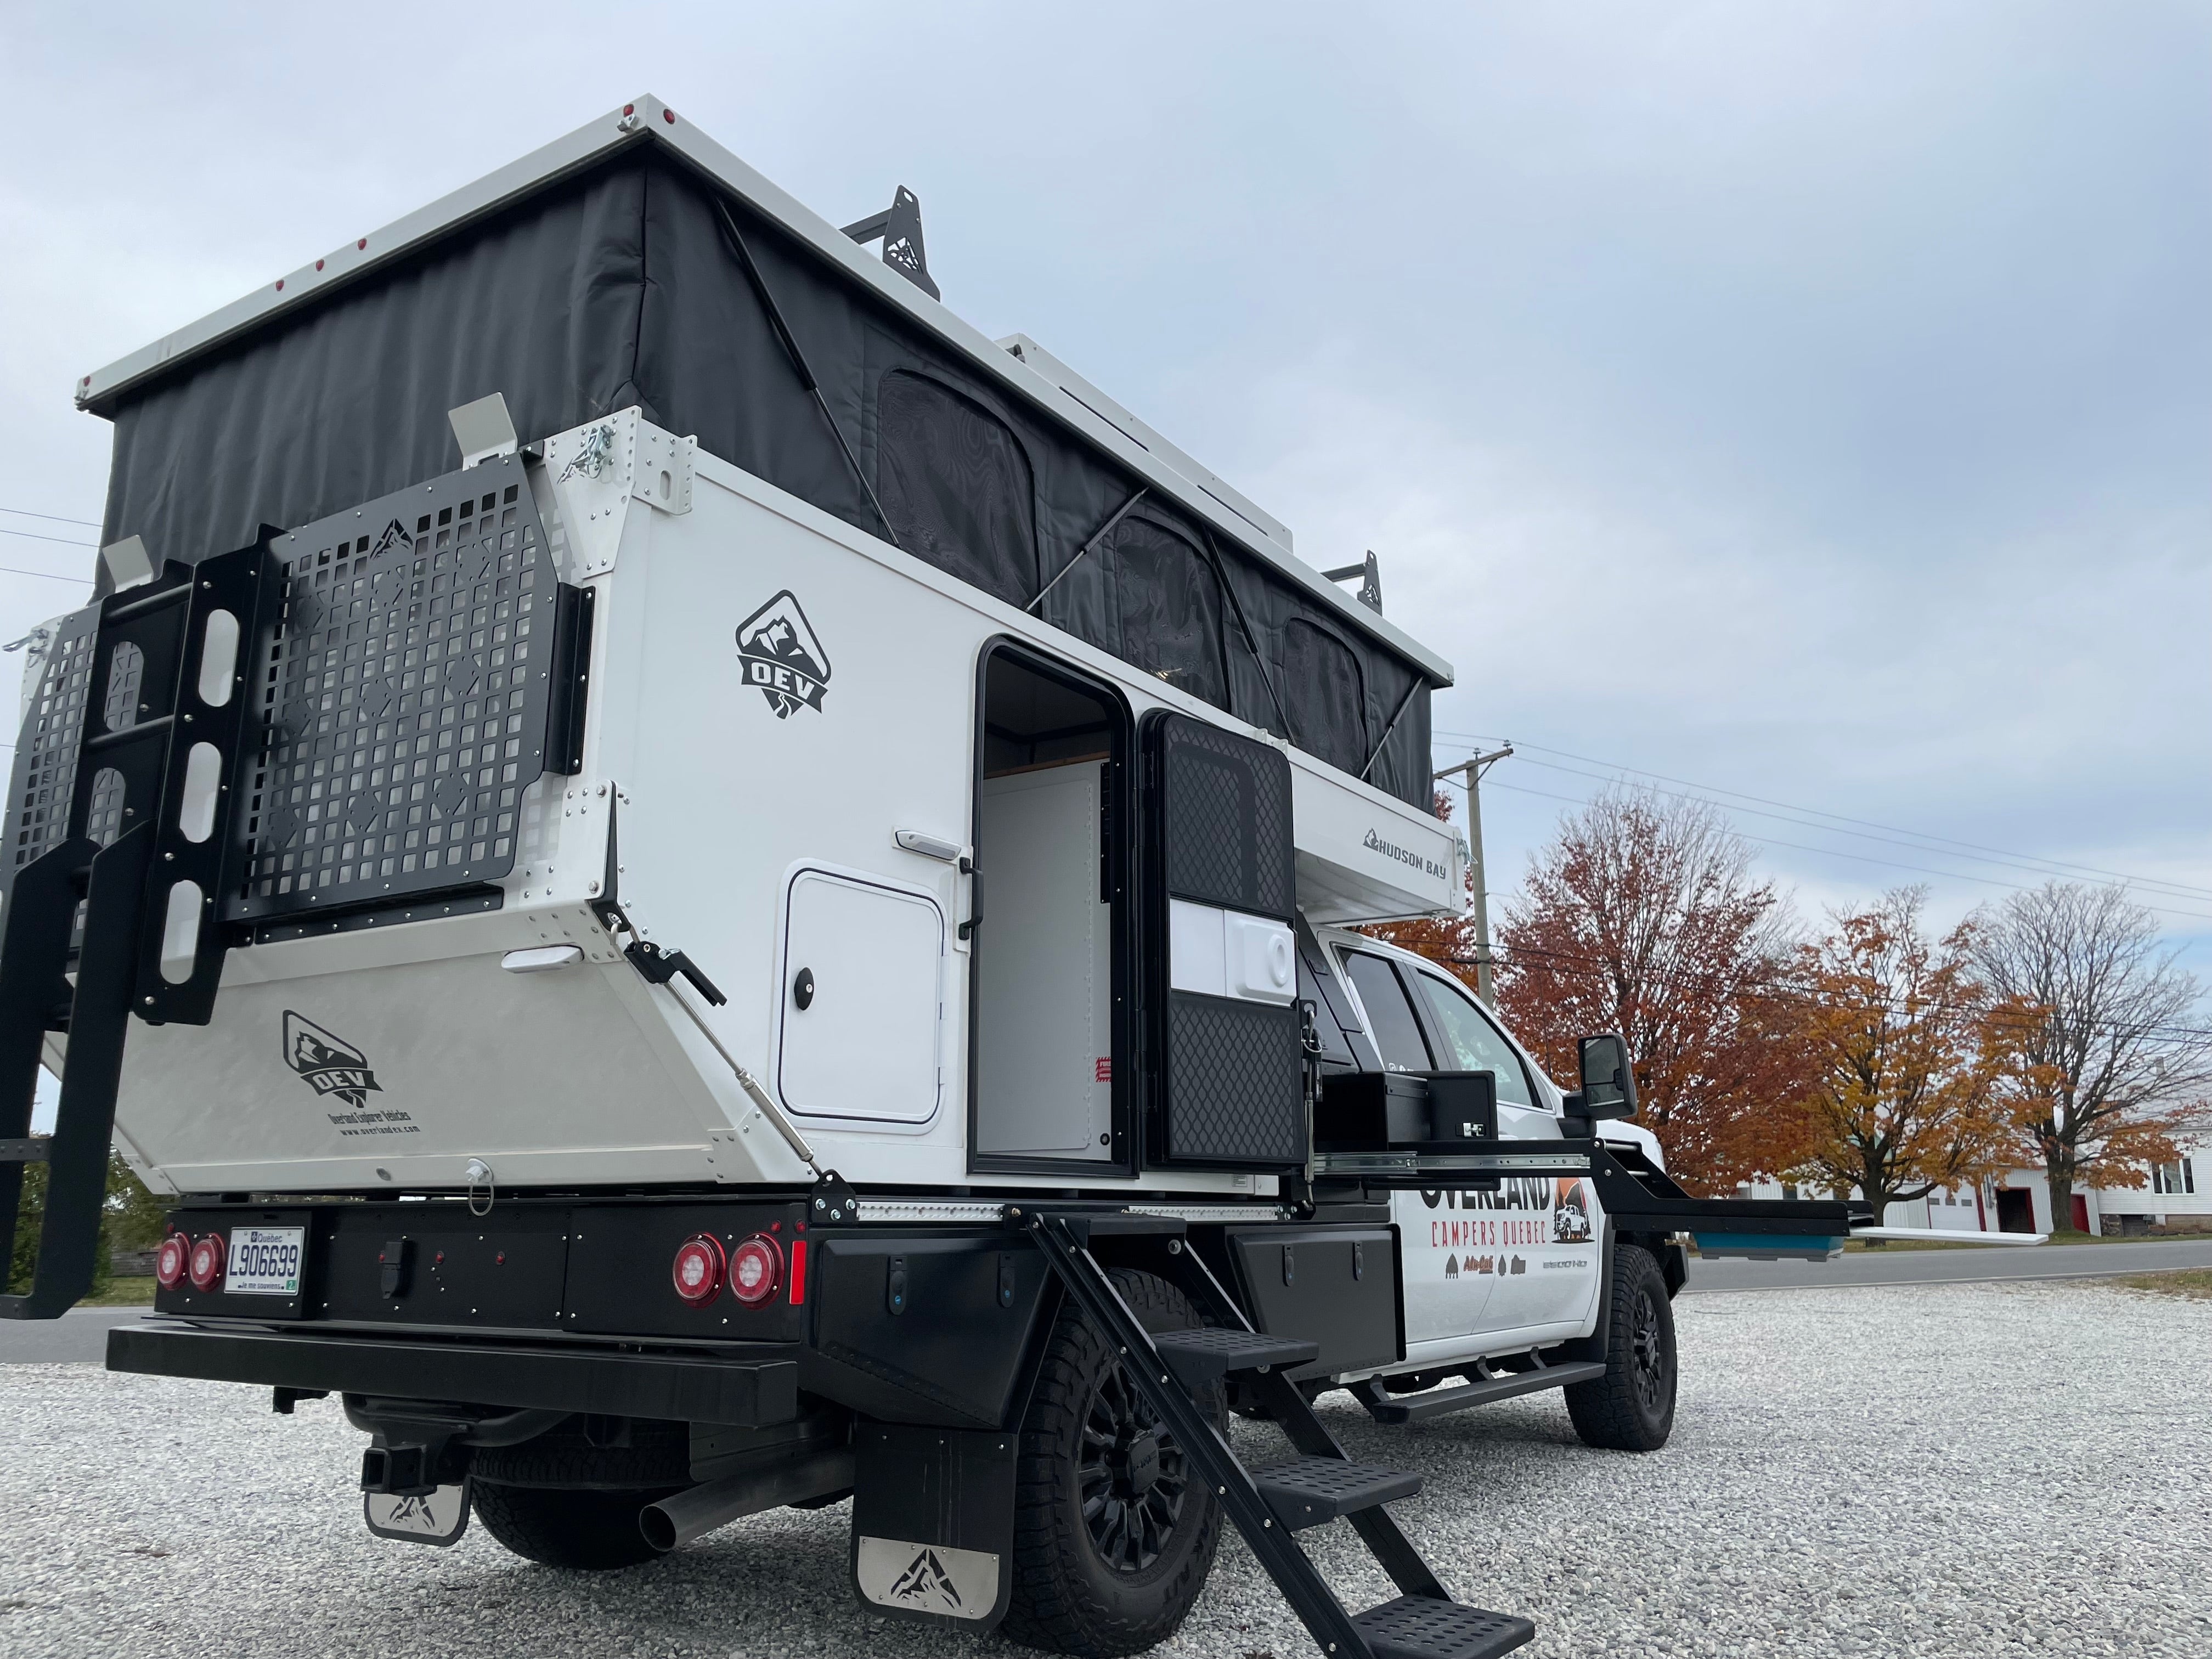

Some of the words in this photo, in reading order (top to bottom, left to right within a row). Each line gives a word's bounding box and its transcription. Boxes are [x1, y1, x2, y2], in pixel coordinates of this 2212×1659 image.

[751, 662, 815, 700] OEV
[1379, 839, 1423, 870] HUDSON
[1426, 860, 1446, 879] BAY
[312, 1071, 365, 1090] OEV
[353, 1111, 384, 1125] Explorer
[380, 1109, 411, 1121] Vehicles
[340, 1126, 421, 1136] www.overlandex.com
[1432, 1221, 1495, 1247] CAMPERS
[1503, 1221, 1545, 1247] QUEBEC
[229, 1244, 298, 1277] L906699
